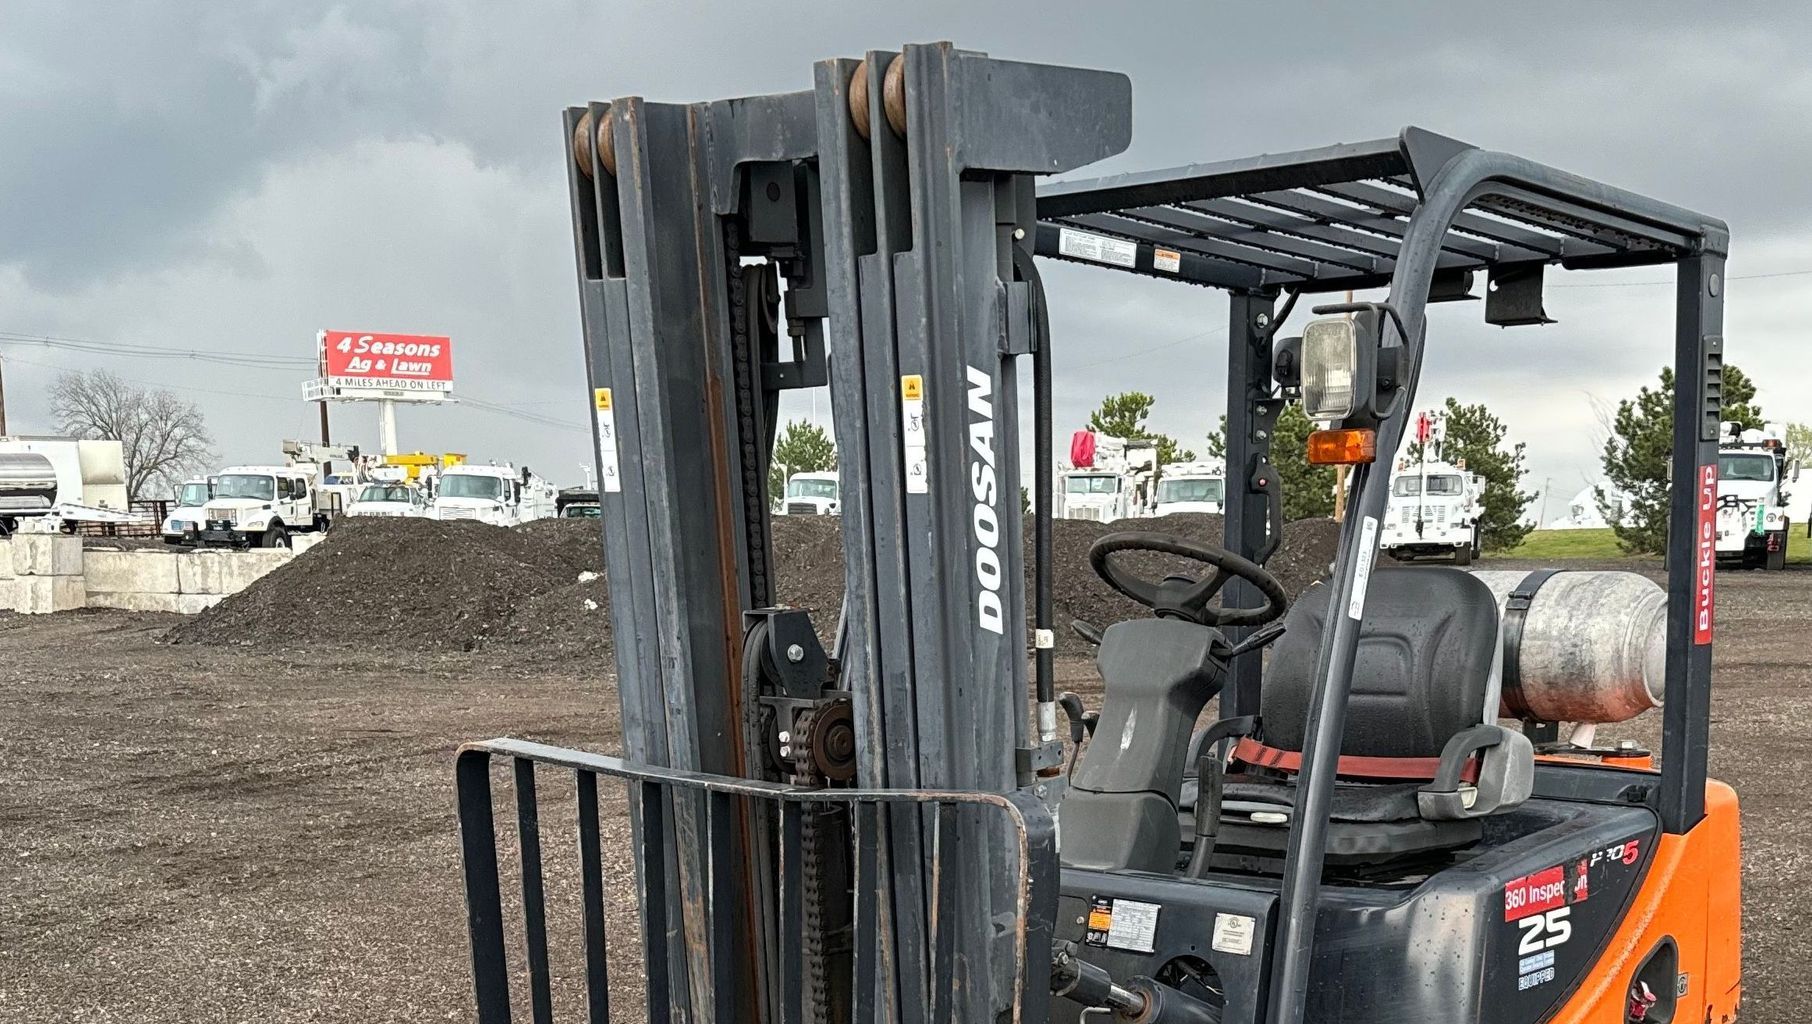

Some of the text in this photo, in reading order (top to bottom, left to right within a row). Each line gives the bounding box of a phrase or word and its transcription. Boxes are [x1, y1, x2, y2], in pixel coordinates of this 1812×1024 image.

[336, 336, 441, 357] 4 Seasons
[345, 356, 432, 375] Ag & Lawn
[345, 378, 373, 387] MILES
[376, 379, 407, 388] AHEAD
[410, 380, 424, 389] ON
[426, 381, 446, 390] LEFT
[967, 365, 1003, 635] DOOSAN
[1700, 521, 1712, 631] Buckle
[1505, 887, 1526, 910] 360
[1518, 906, 1572, 955] 25
